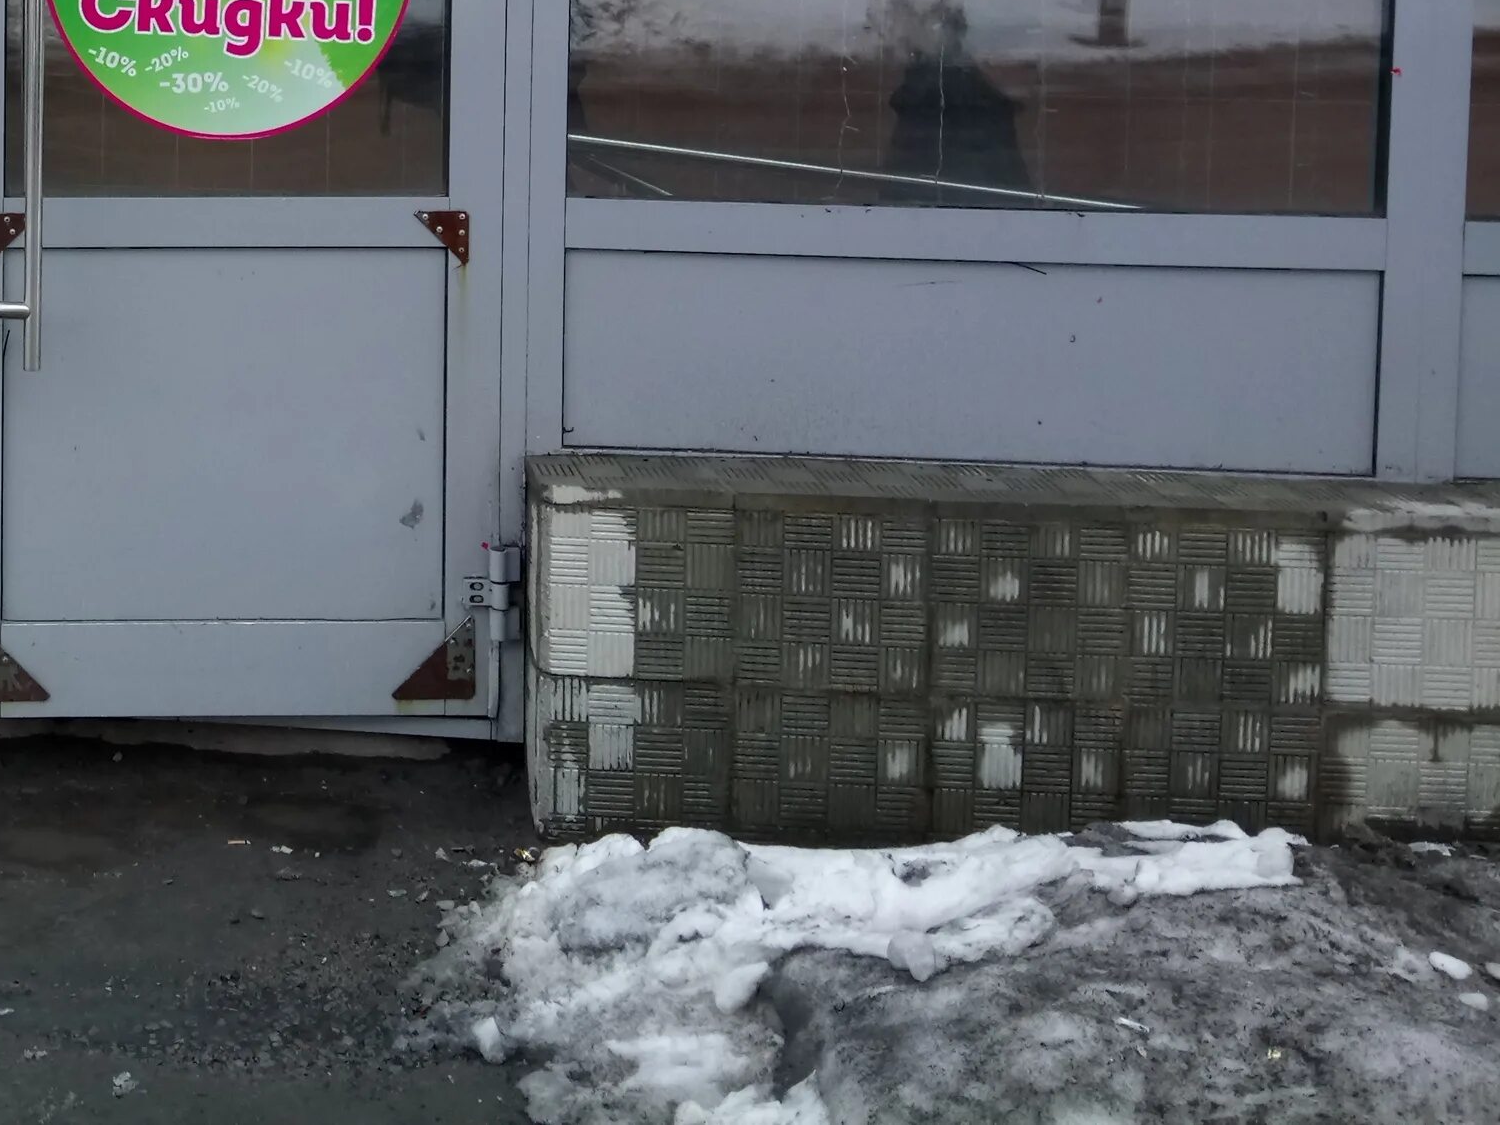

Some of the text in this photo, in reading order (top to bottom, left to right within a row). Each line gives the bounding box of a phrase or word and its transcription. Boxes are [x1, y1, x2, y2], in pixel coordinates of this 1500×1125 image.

[88, 46, 137, 77] -10%
[145, 46, 189, 74] -20%
[284, 57, 333, 88] -10%
[160, 71, 229, 94] -30%
[242, 74, 284, 103] -20%
[204, 97, 240, 114] -10%
